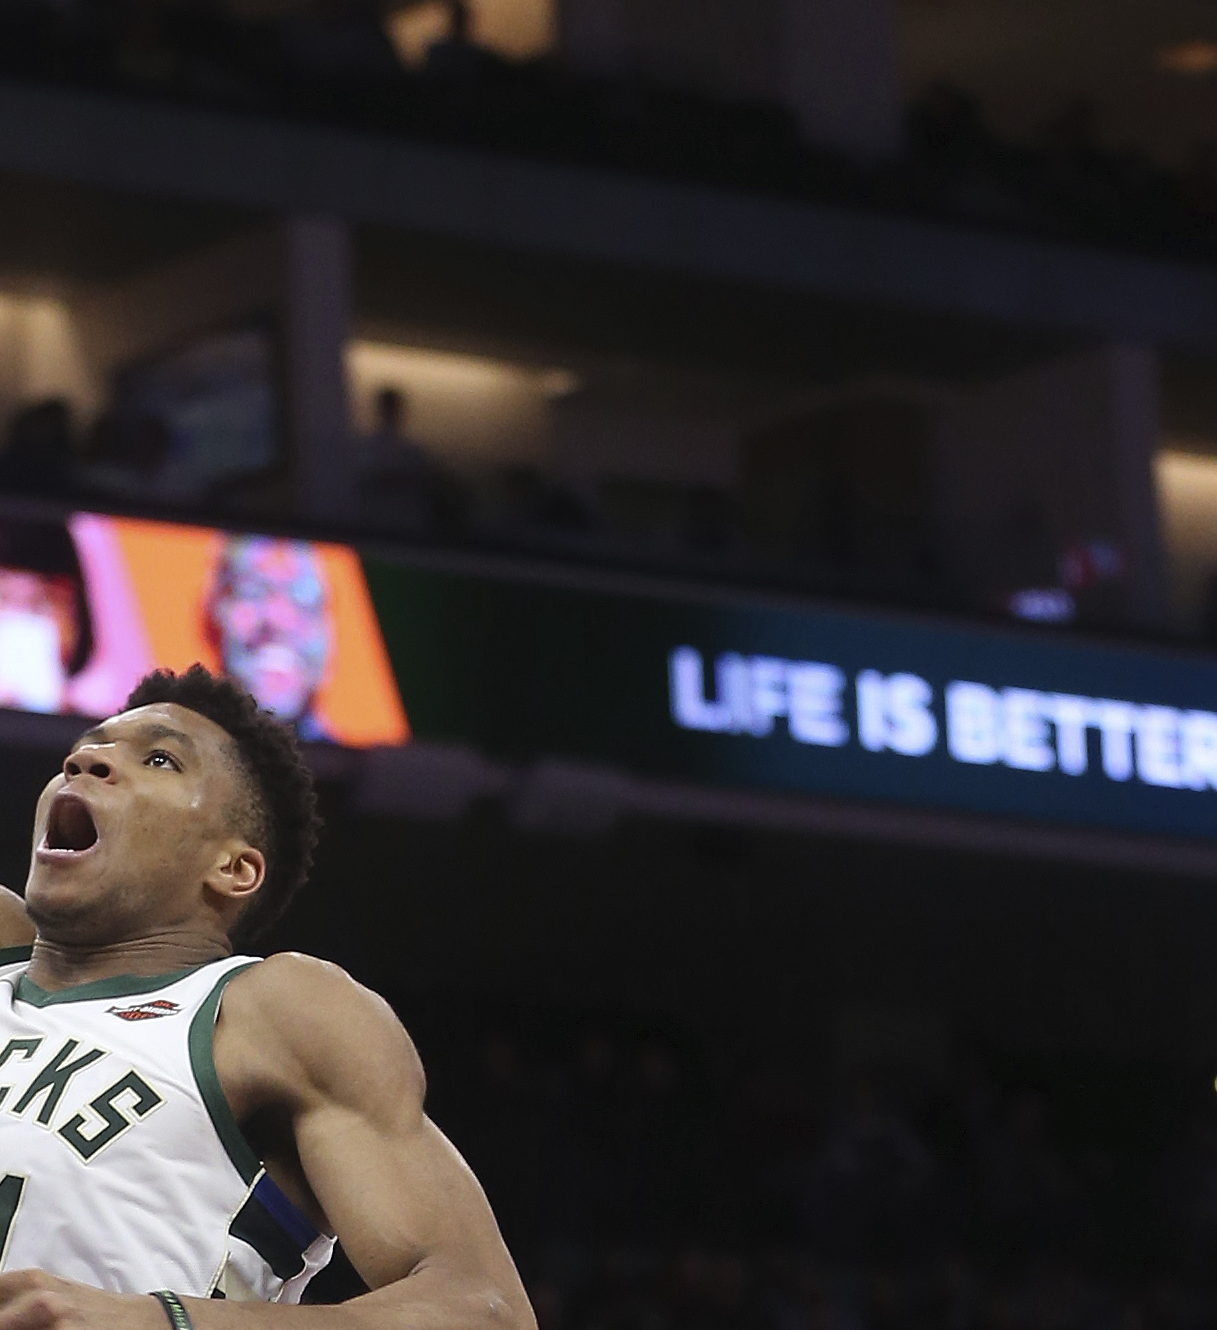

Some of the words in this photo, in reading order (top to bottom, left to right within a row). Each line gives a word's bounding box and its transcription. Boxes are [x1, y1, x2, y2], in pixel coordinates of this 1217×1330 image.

[669, 646, 850, 748] LIFE
[856, 668, 938, 758] IS
[944, 679, 1217, 791] BETTER
